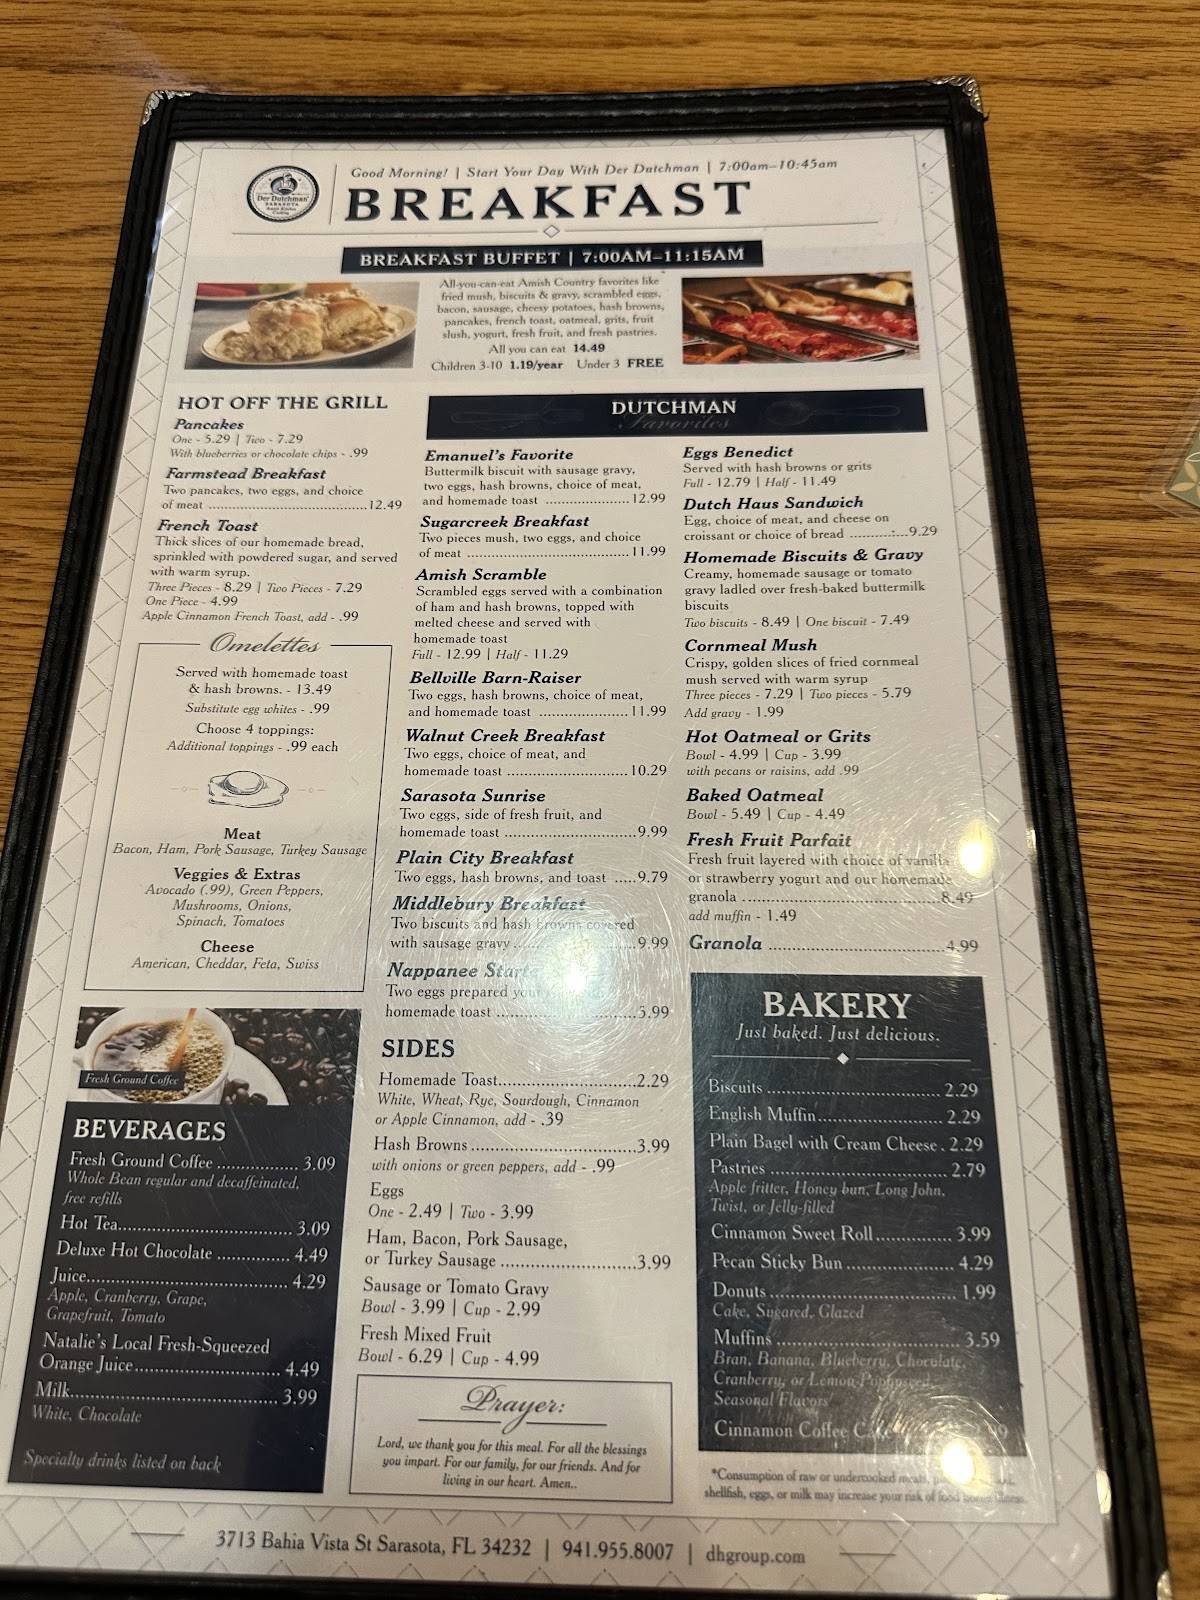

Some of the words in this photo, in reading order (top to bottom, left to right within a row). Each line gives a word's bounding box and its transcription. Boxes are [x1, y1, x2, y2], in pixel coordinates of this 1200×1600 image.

[350, 167, 385, 178] Good
[388, 167, 448, 179] Morning!
[466, 167, 498, 178] Start
[504, 166, 533, 177] Your
[537, 165, 564, 178] Day
[570, 164, 599, 175] With
[604, 163, 629, 175] Der
[633, 162, 699, 174] Dutchman
[344, 181, 750, 221] BREAKFAST
[360, 252, 477, 266] BREAKFAST
[483, 251, 560, 265] BUFFET
[439, 278, 515, 290] All-you-can-eat
[517, 277, 551, 287] Amish
[553, 277, 596, 288] Country
[598, 276, 639, 286] favorites
[642, 276, 660, 285] like
[488, 344, 506, 354] All
[508, 347, 526, 355] you
[573, 343, 606, 353] 14.49
[431, 361, 476, 371] Children
[479, 360, 503, 370] 3-10
[510, 360, 564, 371] 1.19/year
[577, 359, 610, 369] Under
[614, 359, 620, 368] 3
[627, 358, 664, 368] FREE
[178, 396, 224, 410] HOT
[229, 396, 271, 410] OFF
[277, 396, 319, 410] THE
[325, 395, 388, 409] GRILL
[612, 400, 736, 415] DUTCHMAN
[173, 418, 245, 430] Pancakes
[424, 449, 505, 462] Emanuel's
[510, 448, 574, 461] Favorite
[682, 446, 718, 461] Eggs
[723, 446, 793, 458] Benedict
[165, 467, 248, 479] Farmstead
[251, 467, 327, 479] Breakfast
[163, 484, 186, 495] Two
[189, 485, 244, 497] pancakes,
[248, 486, 268, 495] two
[271, 487, 299, 497] eggs,
[303, 485, 325, 495] and
[327, 485, 364, 496] choice
[683, 497, 731, 510] Dutch
[736, 497, 779, 510] Haus
[784, 495, 863, 509] Sandwich
[157, 519, 210, 532] French
[217, 519, 259, 532] Toast
[420, 515, 508, 530] Sugarcreek
[513, 514, 590, 527] Breakfast
[683, 550, 776, 564] Homemade
[781, 550, 847, 562] Biscuits
[853, 548, 868, 561] &
[874, 548, 923, 562] Gravy
[150, 566, 175, 576] with
[178, 568, 210, 577] warm
[213, 570, 250, 579] syrup.
[414, 568, 467, 581] Amish
[472, 568, 547, 581] Scramble
[209, 632, 321, 653] Omelettes
[685, 638, 767, 652] Cornmeal
[771, 638, 817, 651] Mush
[409, 671, 477, 684] Bellville
[481, 670, 582, 684] Barn-Raiser
[196, 722, 241, 734] Choose
[245, 723, 254, 734] 4
[258, 724, 314, 737] toppings:
[406, 728, 465, 742] Walnut
[470, 728, 519, 742] Creek
[523, 728, 606, 742] Breakfast
[685, 729, 718, 743] Hot
[724, 729, 799, 743] Oatmeal
[804, 733, 823, 743] or
[828, 729, 871, 743] Grits
[400, 788, 476, 802] Sarasota
[481, 788, 546, 802] Sunrise
[685, 788, 742, 802] Baked
[747, 787, 824, 802] Oatmeal
[224, 827, 261, 840] Meat
[686, 832, 734, 847] Fresh
[740, 832, 784, 847] Fruit
[789, 833, 852, 847] Parfait
[112, 842, 152, 855] Bacon,
[156, 843, 189, 855] Ham,
[194, 843, 224, 857] Pork
[225, 843, 274, 857] Sausage,
[281, 843, 318, 857] Turkey
[321, 843, 367, 857] Sausage
[395, 849, 442, 864] Plain
[449, 850, 485, 867] City
[489, 850, 574, 865] Breakfast
[174, 867, 229, 882] Veggies
[234, 867, 248, 880] &
[253, 867, 301, 880] Extras
[200, 939, 254, 953] Cheese
[763, 991, 912, 1019] BAKERY
[734, 1023, 766, 1041] Just
[772, 1023, 822, 1042] baked.
[828, 1025, 859, 1042] Just
[865, 1025, 940, 1042] delicious.
[382, 1038, 455, 1058] SIDES
[84, 1072, 111, 1085] Fresh
[111, 1073, 148, 1085] Ground
[149, 1074, 179, 1087] Coffee
[708, 1077, 763, 1095] Biscuits
[944, 1083, 978, 1098] 2.29
[73, 1118, 225, 1141] BEVERAGES
[367, 1228, 406, 1246] Ham,
[412, 1229, 461, 1248] Bacon,
[467, 1230, 500, 1246] Pork
[504, 1230, 567, 1250] Sausage,
[56, 1240, 106, 1257] Deluxe
[110, 1241, 138, 1258] Hot
[143, 1242, 212, 1260] Chocolate
[294, 1247, 328, 1263] 4.49
[712, 1252, 755, 1269] Pecan
[761, 1252, 806, 1272] Sticky
[812, 1253, 843, 1270] Bun
[958, 1255, 994, 1271] 4.29
[360, 1324, 398, 1341] Fresh
[404, 1325, 450, 1343] Mixed
[456, 1327, 491, 1343] Fruit
[460, 1384, 568, 1435] Prayer:
[24, 1449, 84, 1468] Specialty
[87, 1451, 127, 1470] drinks
[132, 1453, 168, 1470] listed
[169, 1460, 186, 1470] on
[190, 1455, 221, 1473] back
[442, 1473, 472, 1489] living
[474, 1475, 484, 1487] in
[487, 1477, 505, 1487] our
[506, 1474, 536, 1488] heart.
[539, 1476, 577, 1489] Amen..
[215, 1529, 256, 1549] 3713
[260, 1530, 305, 1551] Bahia
[310, 1532, 350, 1552] Vista
[353, 1533, 372, 1553] St
[376, 1534, 446, 1556] Sarasota,
[451, 1536, 477, 1555] FL
[481, 1537, 531, 1557] 34232
[562, 1540, 674, 1561] 941.955.8007
[706, 1544, 806, 1566] dhgroup.com
